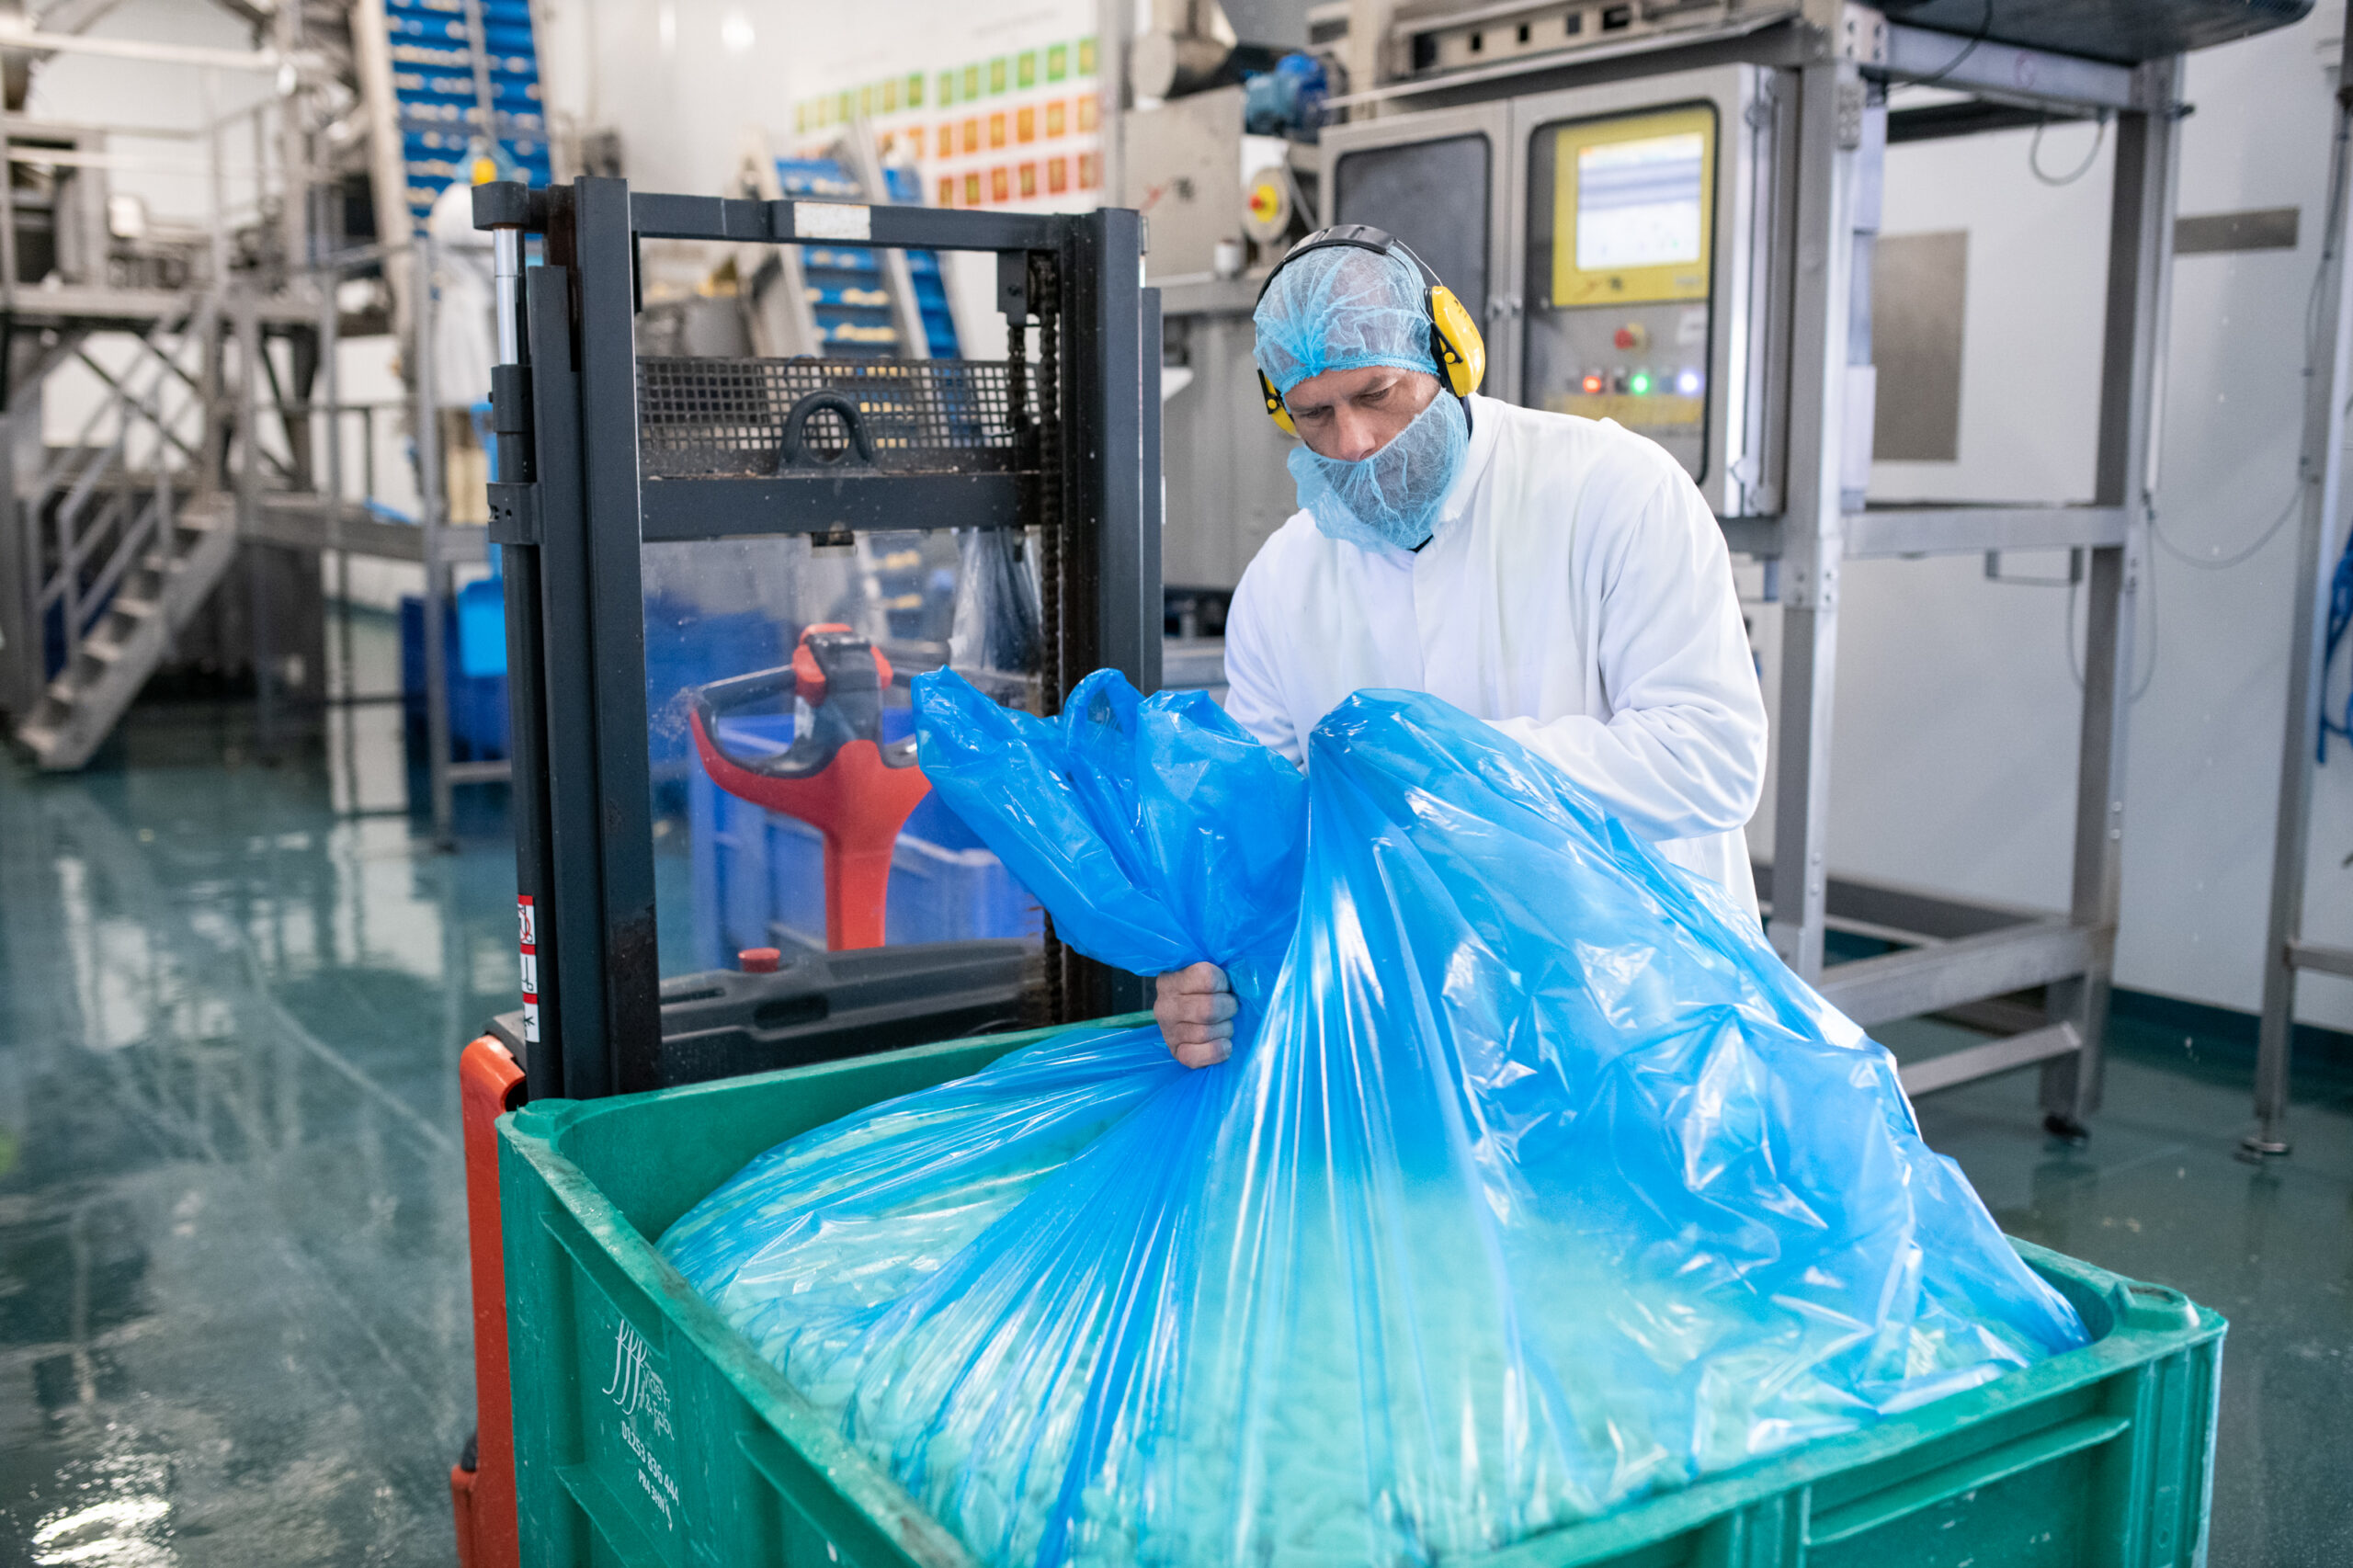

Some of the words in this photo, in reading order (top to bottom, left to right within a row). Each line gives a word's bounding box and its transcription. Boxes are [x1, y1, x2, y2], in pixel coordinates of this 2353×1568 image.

[620, 1420, 646, 1463] 01253
[647, 1451, 663, 1484] 836
[664, 1473, 679, 1506] 444
